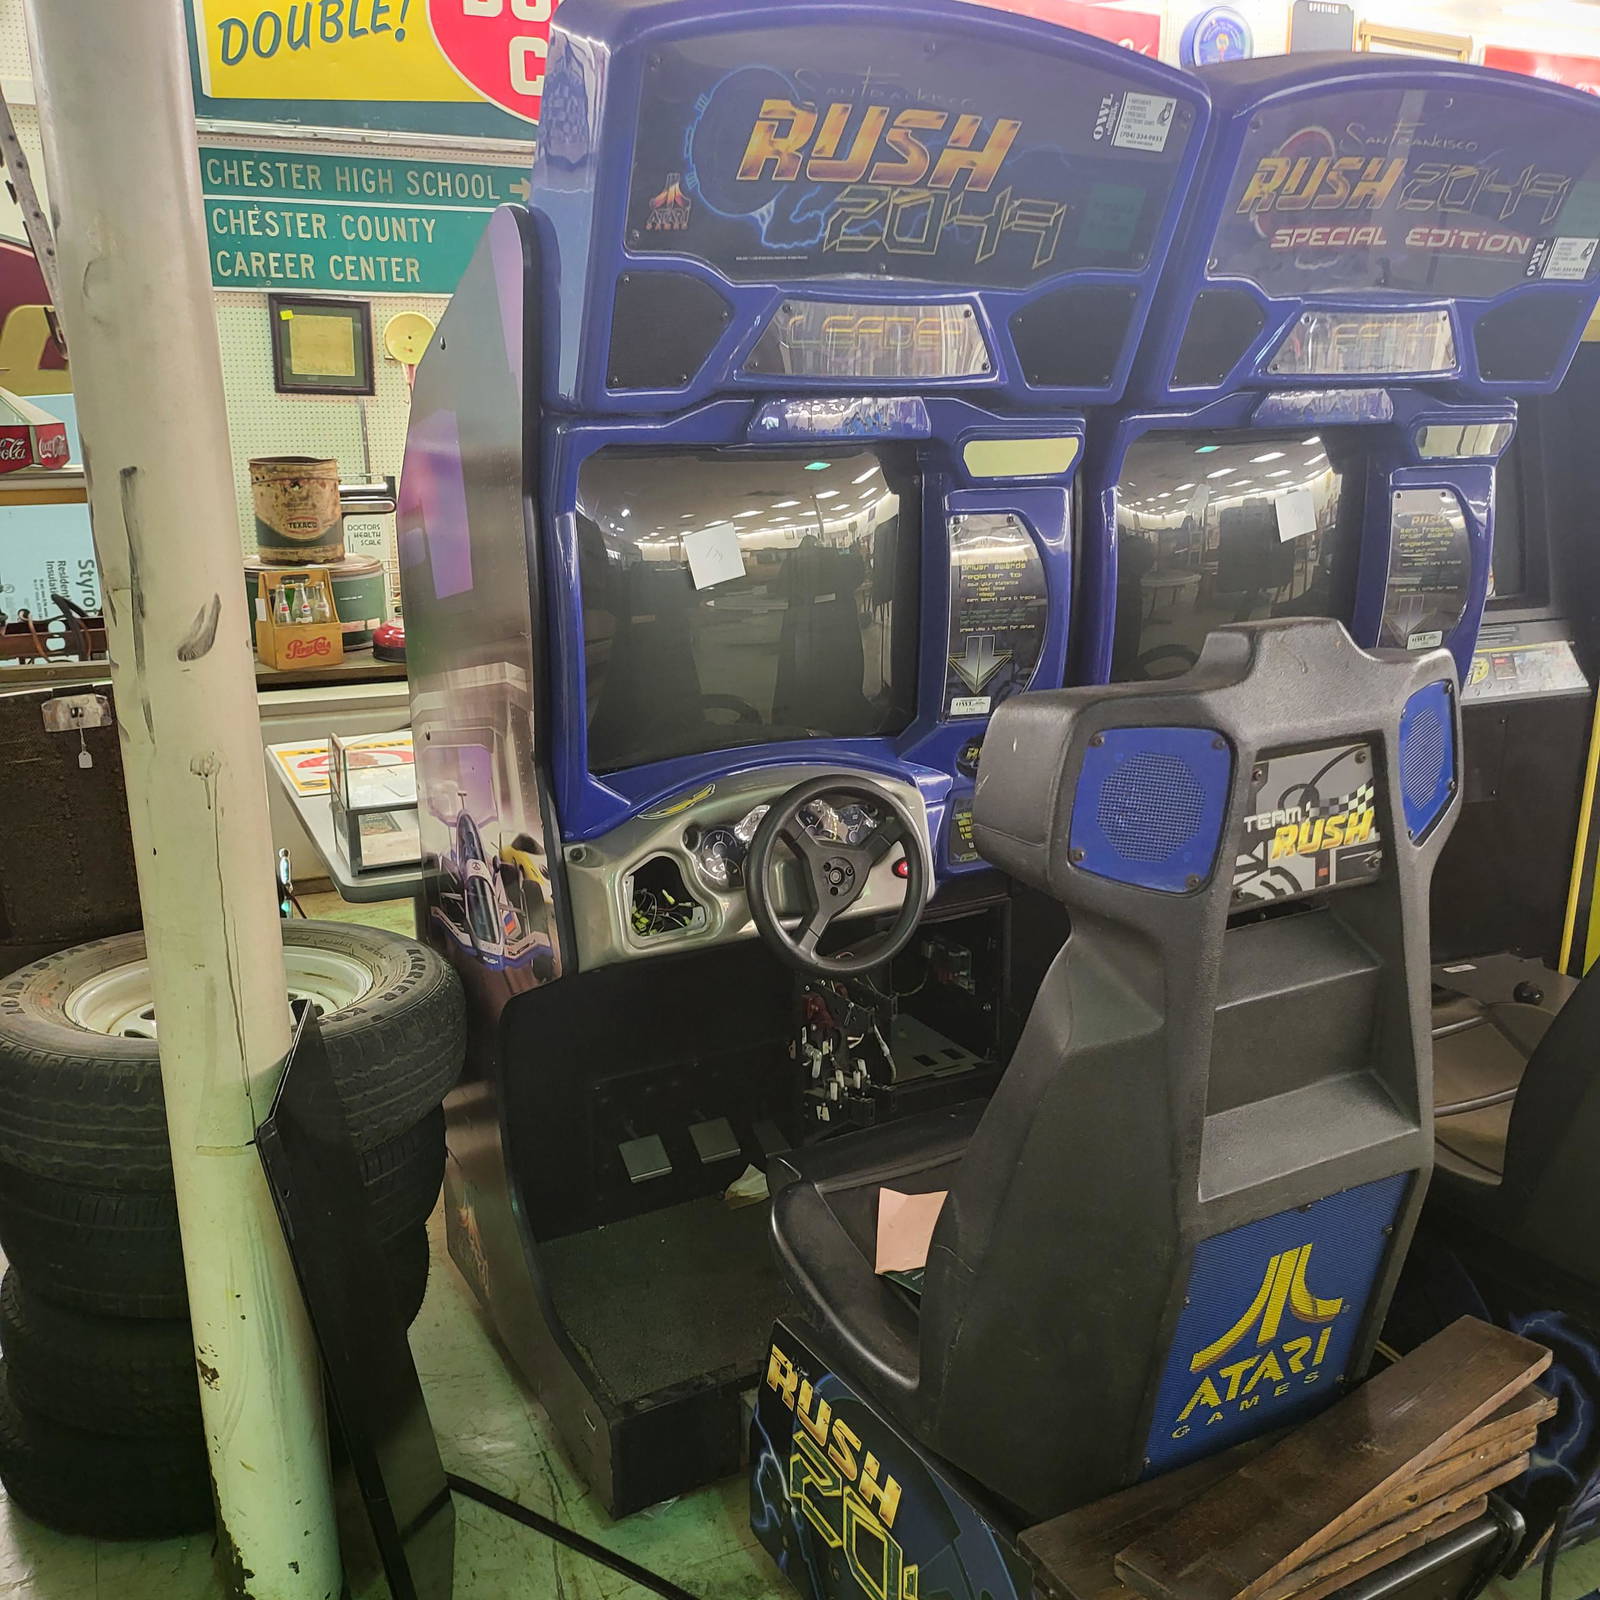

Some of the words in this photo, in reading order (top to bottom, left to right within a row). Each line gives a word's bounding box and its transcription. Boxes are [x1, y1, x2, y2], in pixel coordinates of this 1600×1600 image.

[218, 0, 409, 65] DOUBLE!
[736, 98, 1023, 193] RUSH
[206, 158, 322, 191] CHESTER
[336, 166, 394, 195] HIGH
[406, 170, 501, 201] SCHOOL
[1235, 156, 1406, 214] RUSH
[1399, 160, 1573, 226] 2049
[212, 206, 327, 240] CHESTER
[341, 214, 437, 244] COUNTY
[822, 185, 1067, 270] 2049
[1270, 226, 1387, 249] SPECIAL
[216, 251, 315, 280] CAREER
[329, 255, 421, 283] CENTER
[288, 521, 318, 529] TEXACO
[1244, 806, 1302, 833] TEAM
[1272, 808, 1375, 860] RUSH
[1176, 1326, 1332, 1421] ATARI
[1171, 1371, 1319, 1439] GAMES
[766, 1343, 902, 1529] RUSH
